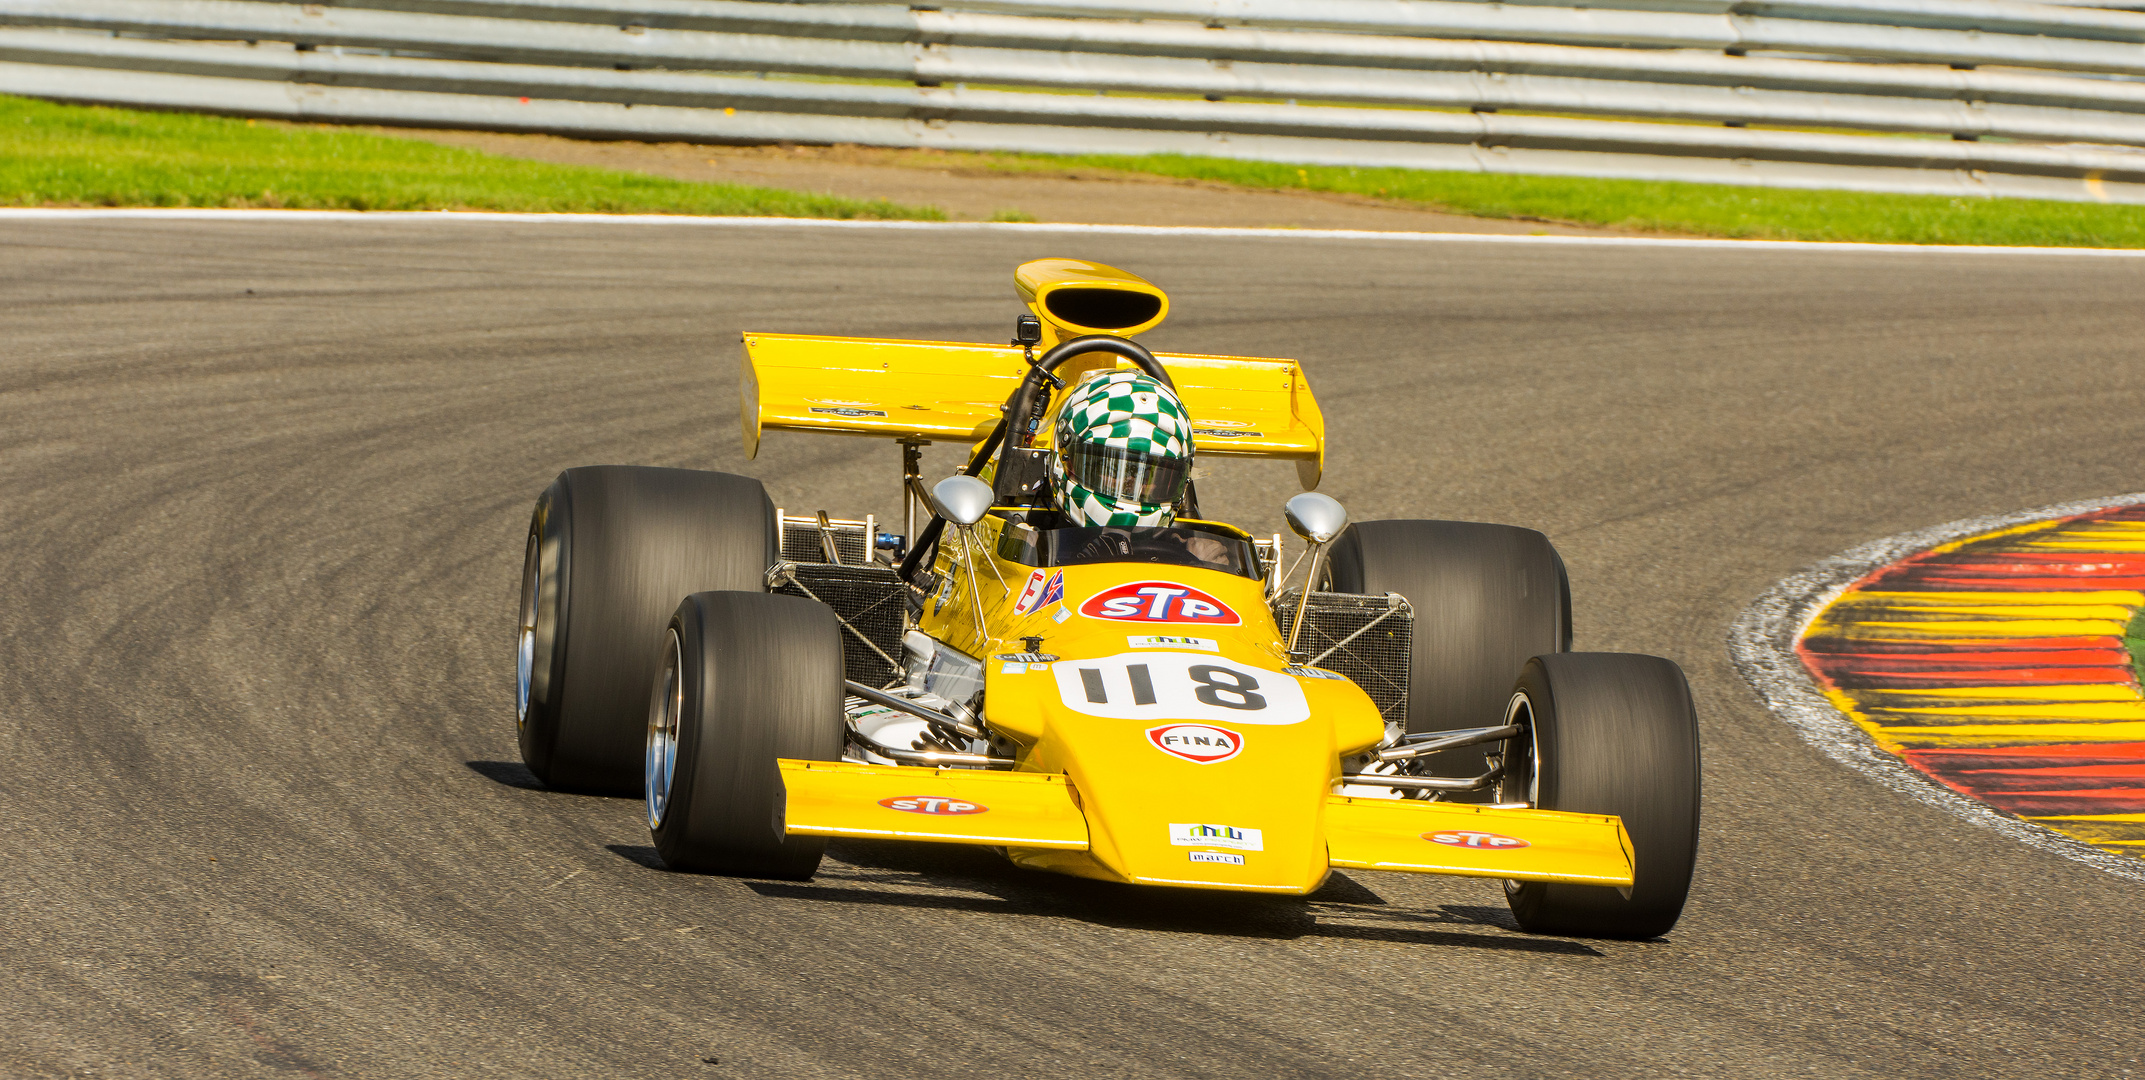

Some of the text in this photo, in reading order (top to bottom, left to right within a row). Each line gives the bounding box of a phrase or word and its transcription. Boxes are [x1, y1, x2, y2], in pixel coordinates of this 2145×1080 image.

[1099, 587, 1225, 620] STP
[1078, 663, 1268, 711] 118
[1163, 735, 1231, 749] FINA
[891, 797, 978, 813] STP
[1432, 832, 1520, 847] STP
[1193, 854, 1241, 864] march
